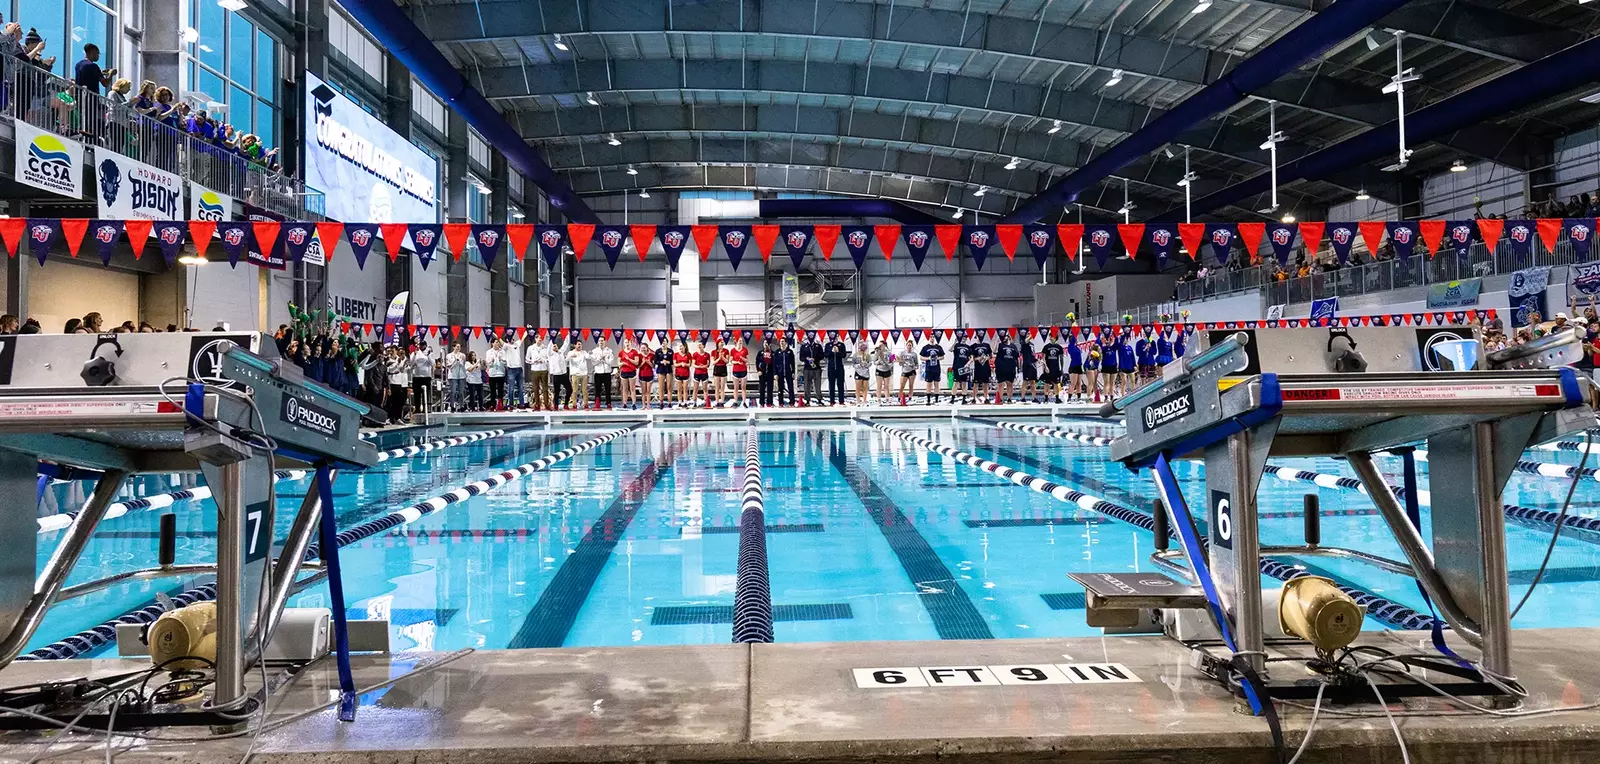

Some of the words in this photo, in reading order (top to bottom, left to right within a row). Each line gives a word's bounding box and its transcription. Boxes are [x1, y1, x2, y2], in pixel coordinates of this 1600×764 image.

[28, 157, 71, 182] CCSA
[137, 167, 172, 186] HOWARD
[128, 169, 180, 220] BISON
[308, 244, 321, 256] CSA
[1578, 264, 1600, 278] FA
[335, 295, 377, 321] LIBERTY
[1154, 394, 1190, 419] PADDOCK
[1285, 389, 1333, 399] DANGER!
[298, 406, 336, 431] PADDOCK
[248, 510, 262, 555] 7
[1217, 501, 1231, 540] 6
[873, 670, 908, 684] 6
[929, 668, 983, 683] FT
[1010, 667, 1048, 681] 9
[1069, 666, 1130, 680] IN
